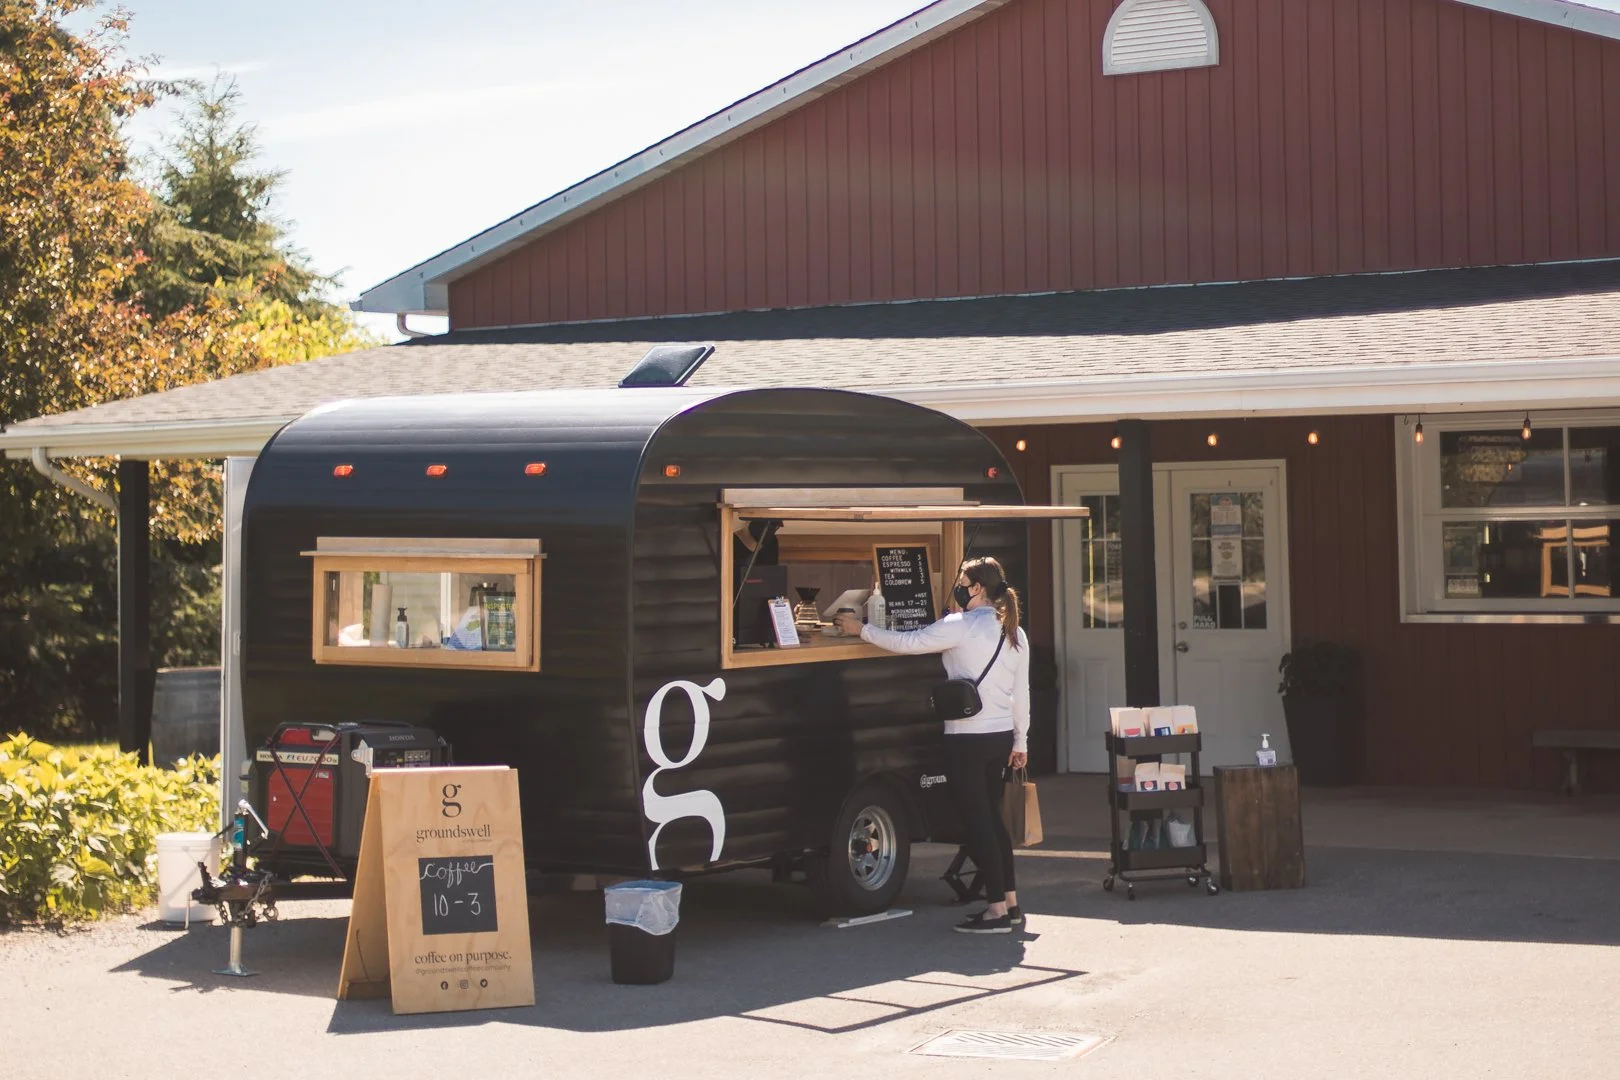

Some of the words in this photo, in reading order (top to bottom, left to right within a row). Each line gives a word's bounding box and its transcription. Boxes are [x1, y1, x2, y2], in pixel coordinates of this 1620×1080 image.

[643, 677, 726, 870] g
[442, 783, 462, 818] g
[416, 824, 491, 844] groundswell
[414, 951, 447, 965] coffee
[449, 952, 463, 962] on
[466, 950, 512, 965] purpose.
